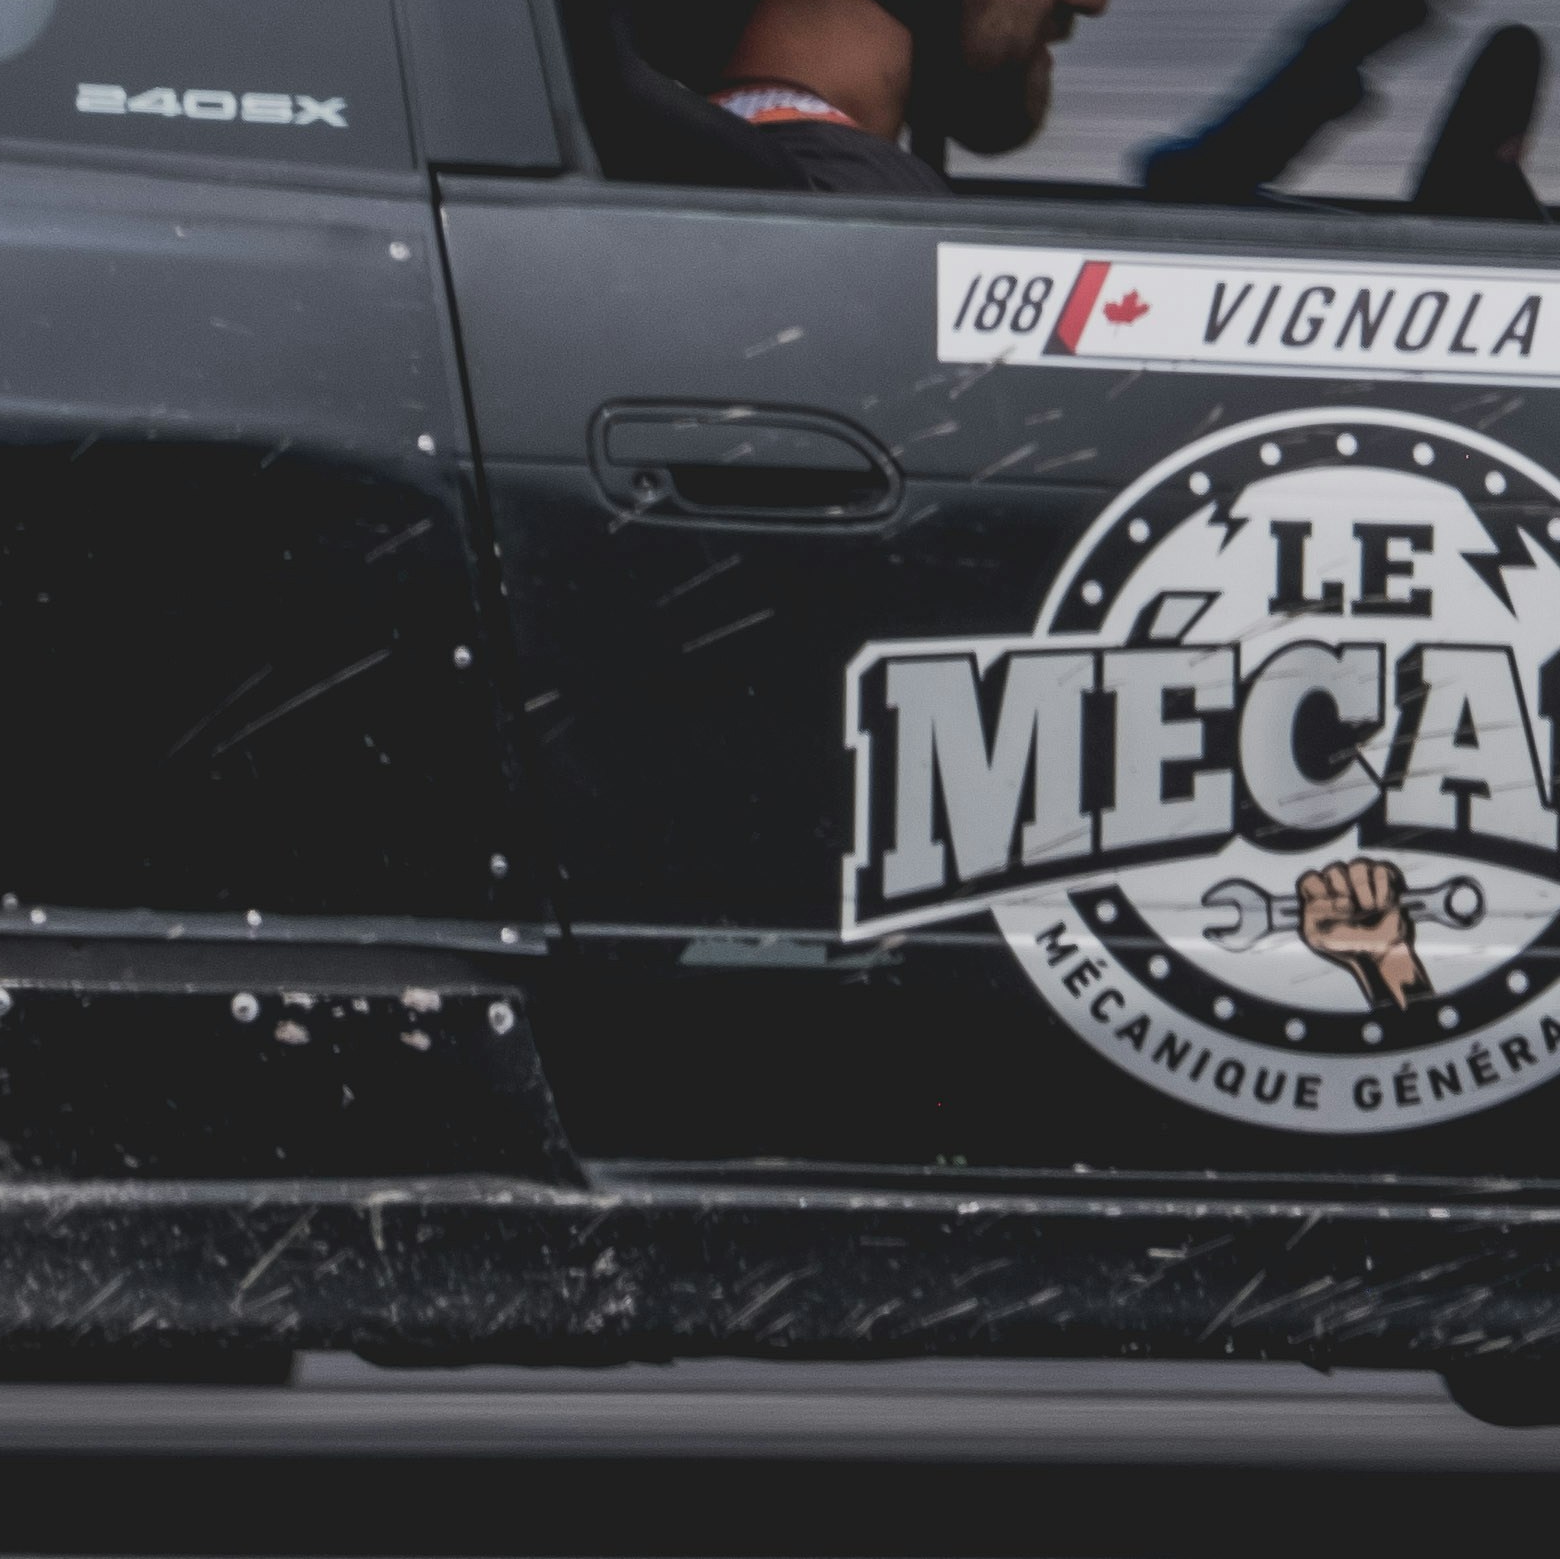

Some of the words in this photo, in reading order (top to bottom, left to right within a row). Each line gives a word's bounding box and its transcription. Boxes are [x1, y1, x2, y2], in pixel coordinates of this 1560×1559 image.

[77, 83, 348, 128] 240SX
[954, 274, 1052, 334] 188
[1202, 282, 1544, 356] VIGNOLA
[1269, 521, 1435, 617] LE
[1033, 922, 1322, 1111] MÉCANIQUE
